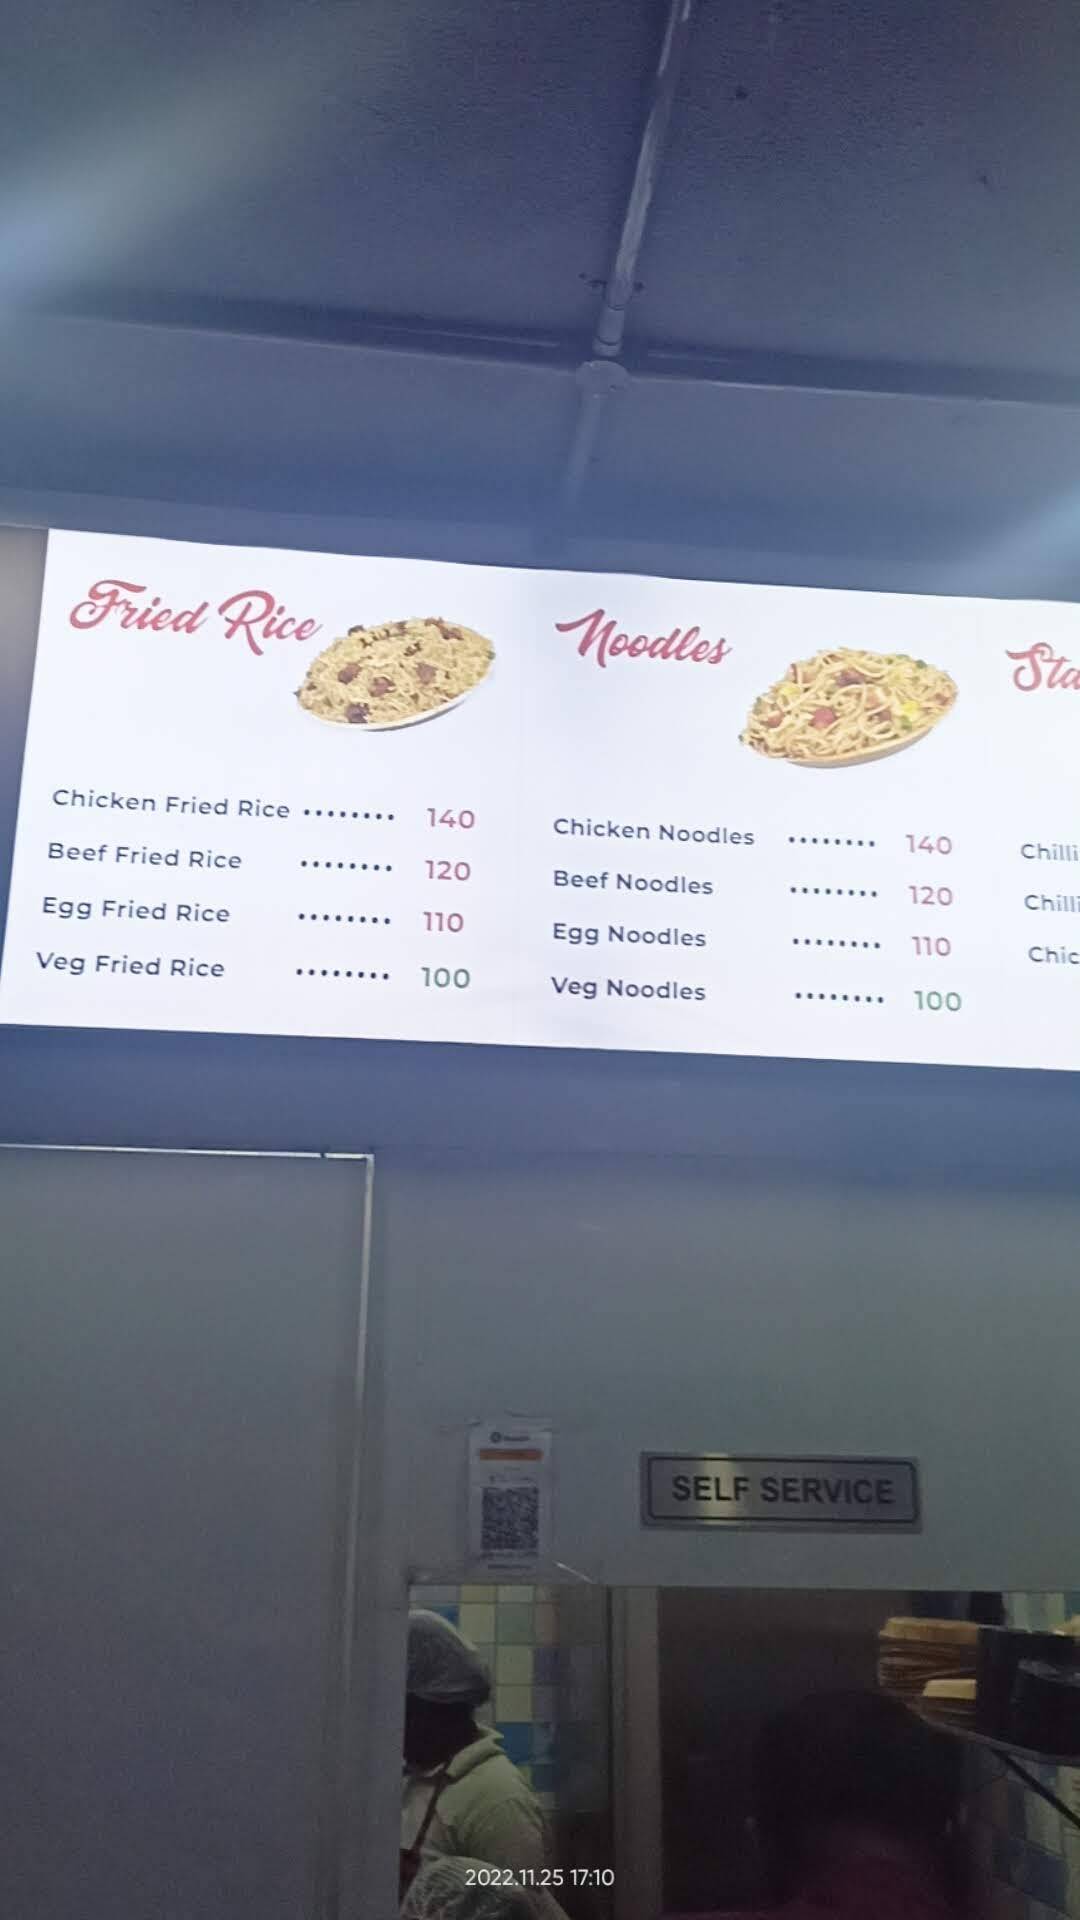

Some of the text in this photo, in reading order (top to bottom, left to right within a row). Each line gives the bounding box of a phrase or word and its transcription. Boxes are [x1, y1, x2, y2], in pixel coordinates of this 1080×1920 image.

[69, 579, 324, 656] Fried Rice
[554, 608, 733, 669] Noodles
[52, 788, 476, 830] Chicken Fried Rice 140
[553, 817, 953, 856] Chicken Noodles 140
[1020, 842, 1079, 862] Chilli
[47, 842, 471, 882] Beef Fried Rice 120
[553, 869, 953, 907] Beef Noodles 120
[42, 896, 464, 934] Egg Fried Rice 110
[553, 922, 952, 957] Egg Noodles 110
[35, 951, 471, 990] Veg Fried Rice 100
[550, 976, 962, 1012] Veg Noodles 100
[671, 1475, 895, 1505] SELF SERVICE
